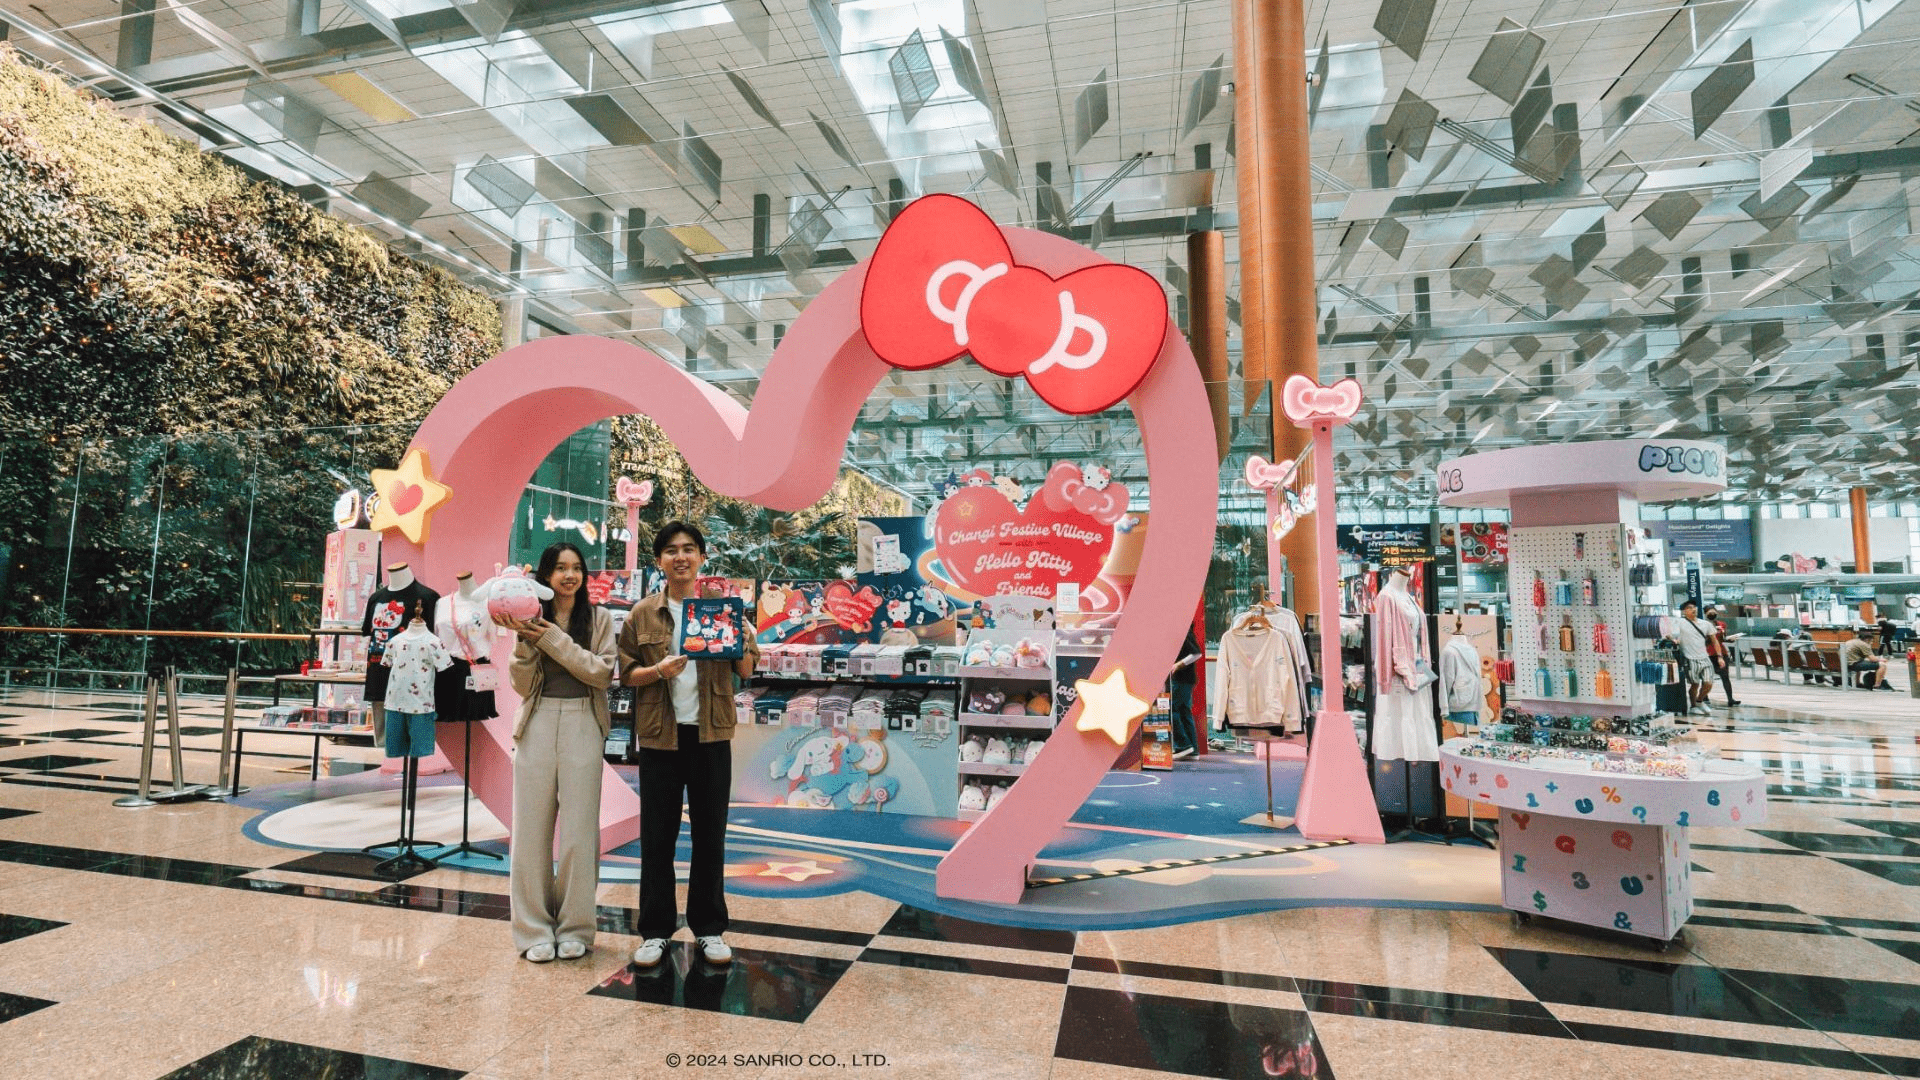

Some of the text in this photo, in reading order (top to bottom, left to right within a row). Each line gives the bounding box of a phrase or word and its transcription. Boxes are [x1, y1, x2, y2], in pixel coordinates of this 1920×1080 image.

[949, 521, 1103, 545] Changi Festive Village
[974, 551, 1073, 577] Hello Kitty
[1014, 571, 1033, 580] and
[1689, 571, 1697, 598] Trolleys
[996, 581, 1051, 597] Friends
[1571, 871, 1590, 890] 3
[1533, 890, 1547, 912] $
